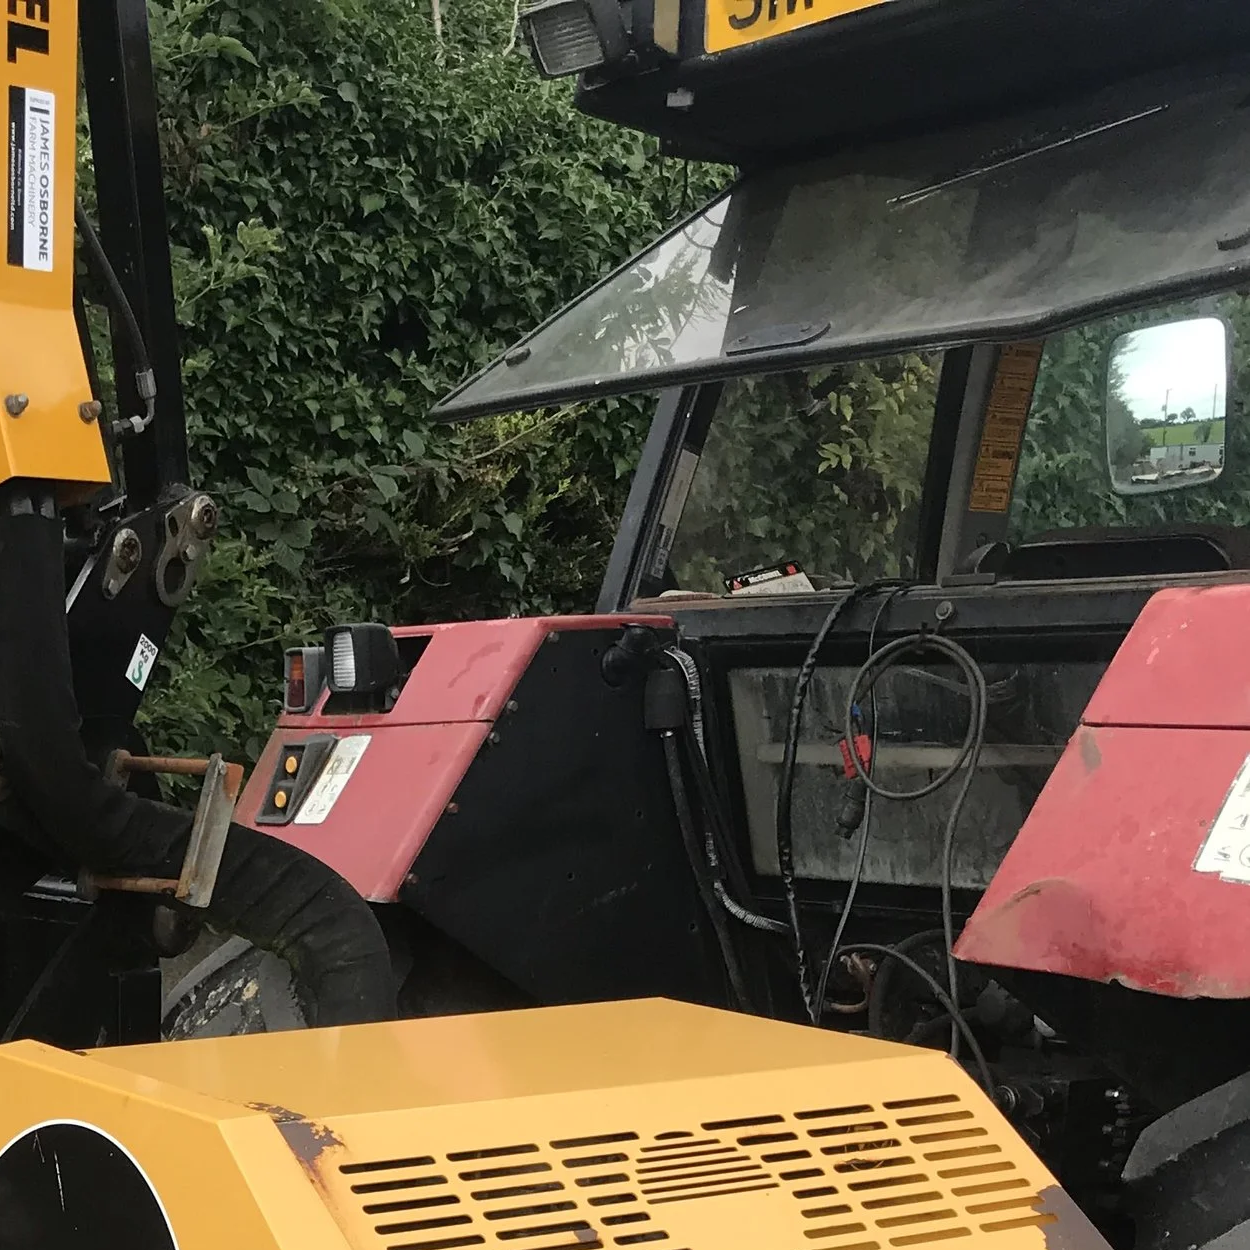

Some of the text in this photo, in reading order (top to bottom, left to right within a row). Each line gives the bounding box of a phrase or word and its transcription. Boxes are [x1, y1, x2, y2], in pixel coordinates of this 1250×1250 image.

[27, 116, 36, 227] FARM MACHINERY
[38, 118, 49, 262] JAMES OSBORNE
[140, 637, 156, 656] 2000
